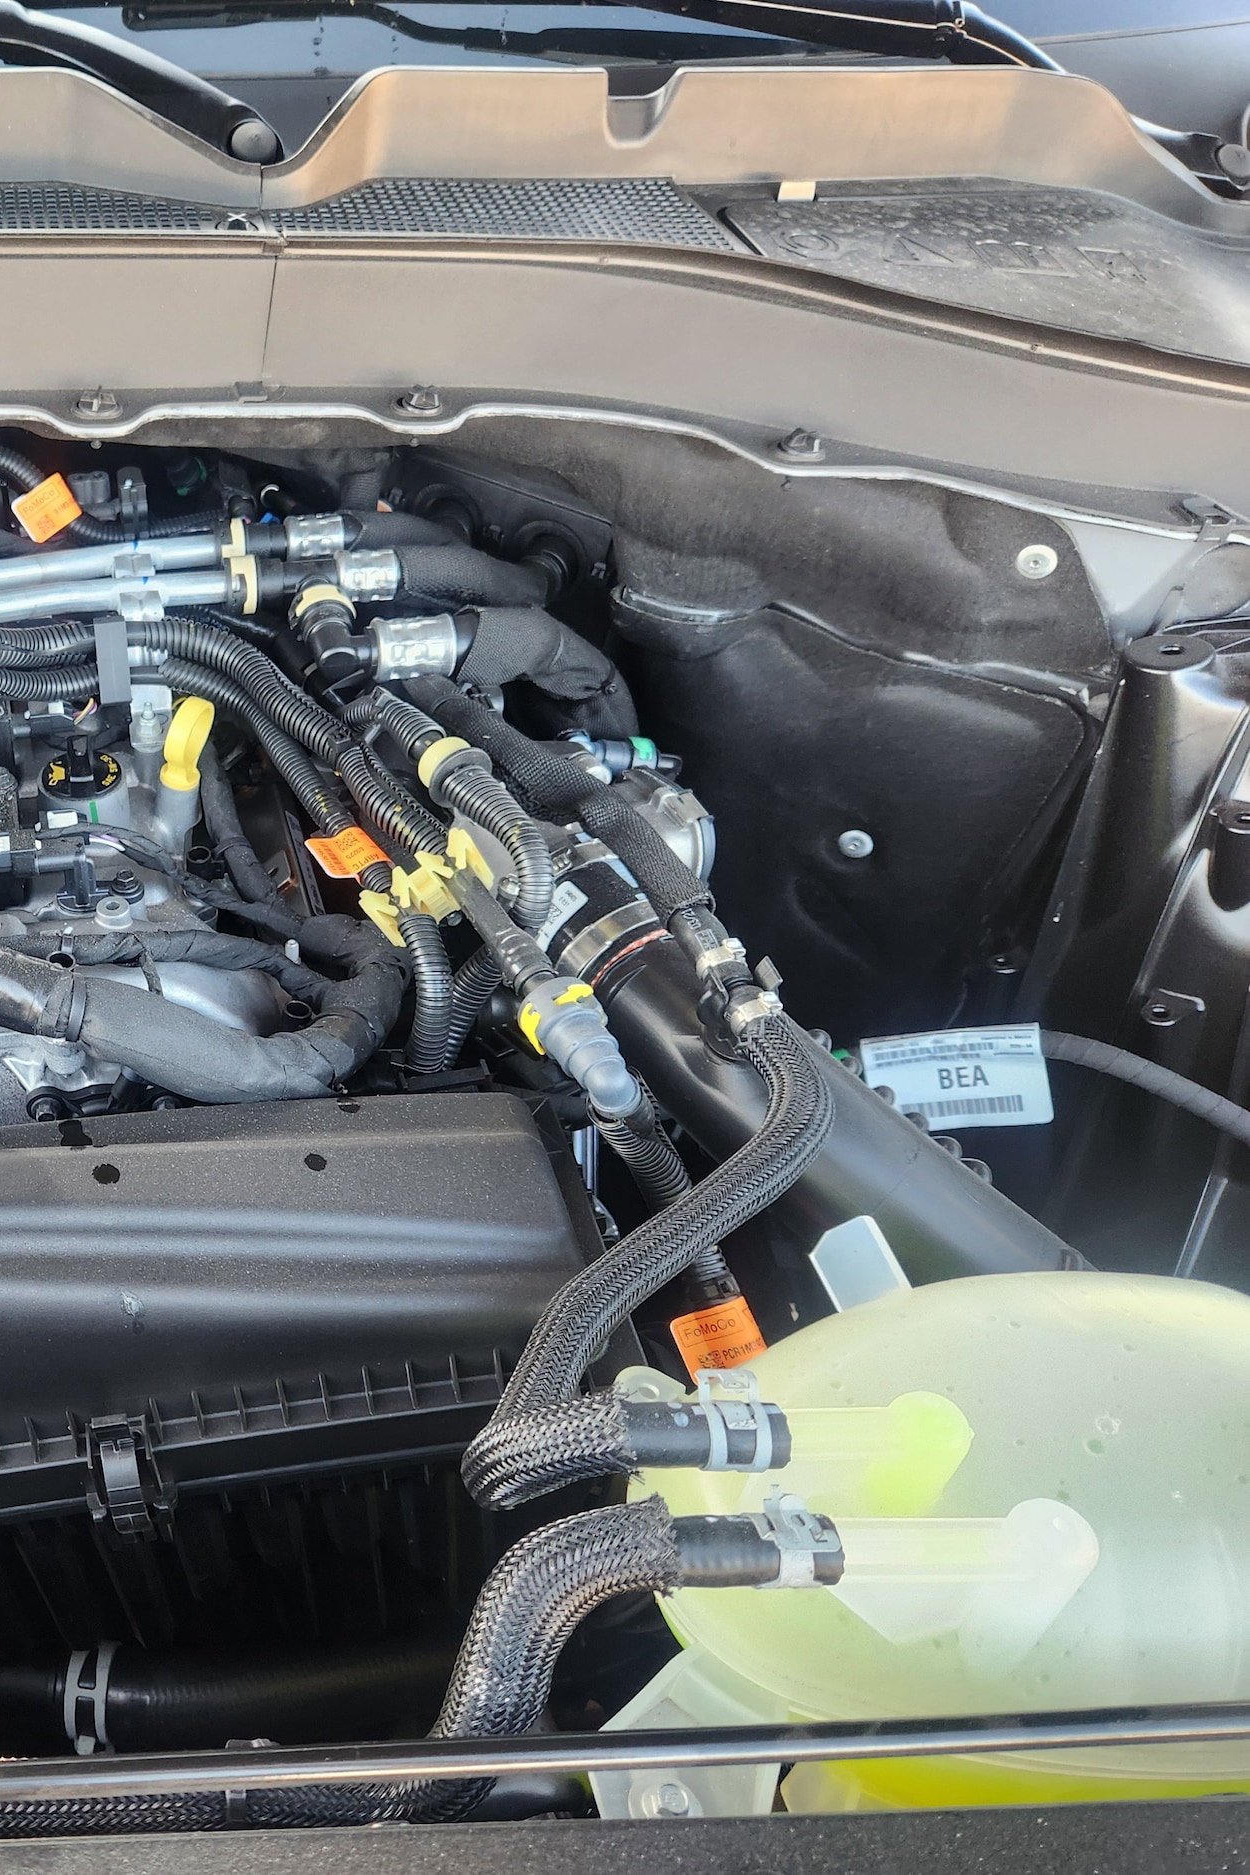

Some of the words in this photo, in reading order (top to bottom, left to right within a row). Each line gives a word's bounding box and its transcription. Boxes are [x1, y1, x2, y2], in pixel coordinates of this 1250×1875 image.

[22, 489, 55, 516] FoMoCo
[937, 1065, 990, 1090] BEA
[683, 1318, 737, 1341] FoMoCo
